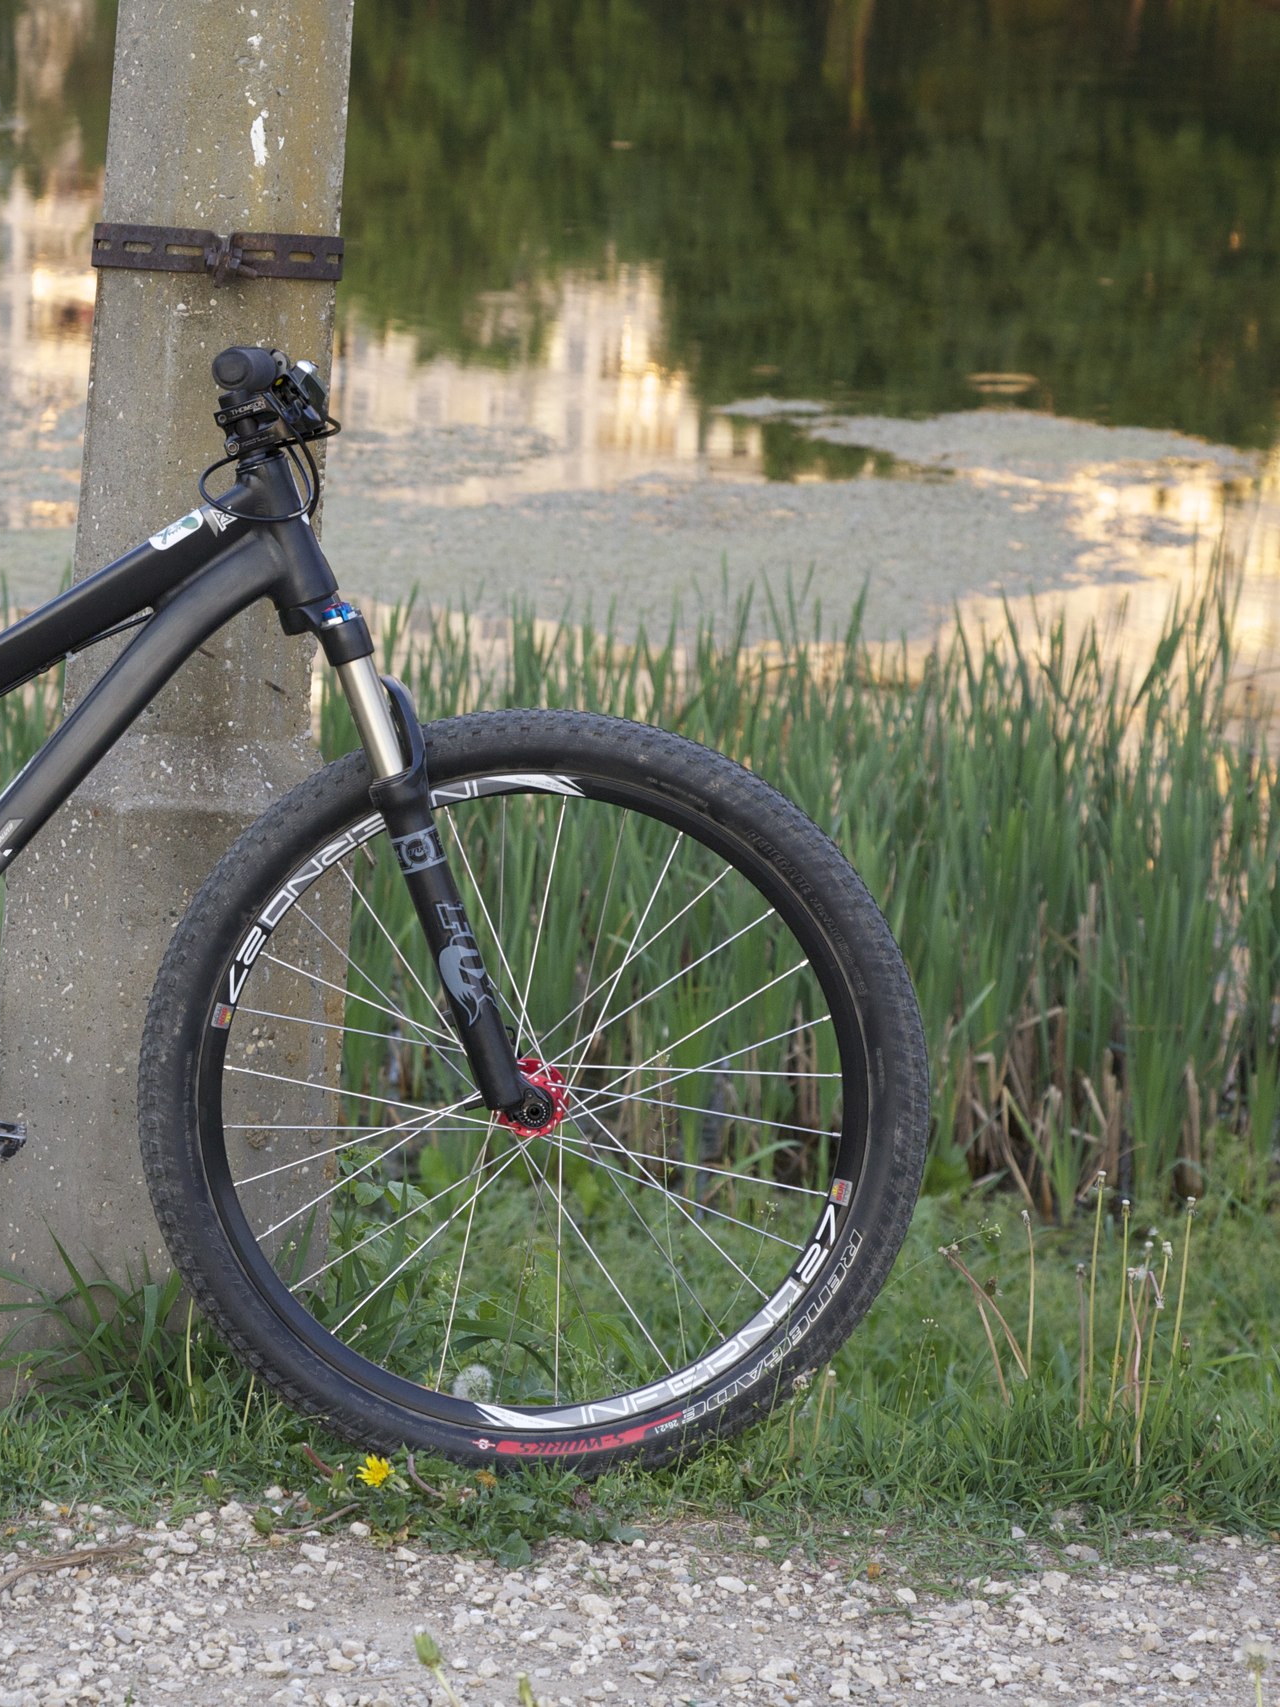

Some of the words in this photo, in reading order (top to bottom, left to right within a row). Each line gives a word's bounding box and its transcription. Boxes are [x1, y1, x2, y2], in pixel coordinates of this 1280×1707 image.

[259, 779, 479, 931] INERNO
[229, 926, 267, 1004] 27
[581, 1277, 804, 1425] INFERNO
[795, 1203, 836, 1285] 27
[681, 1228, 863, 1425] RENEGADE
[520, 1431, 629, 1456] S-WORKS
